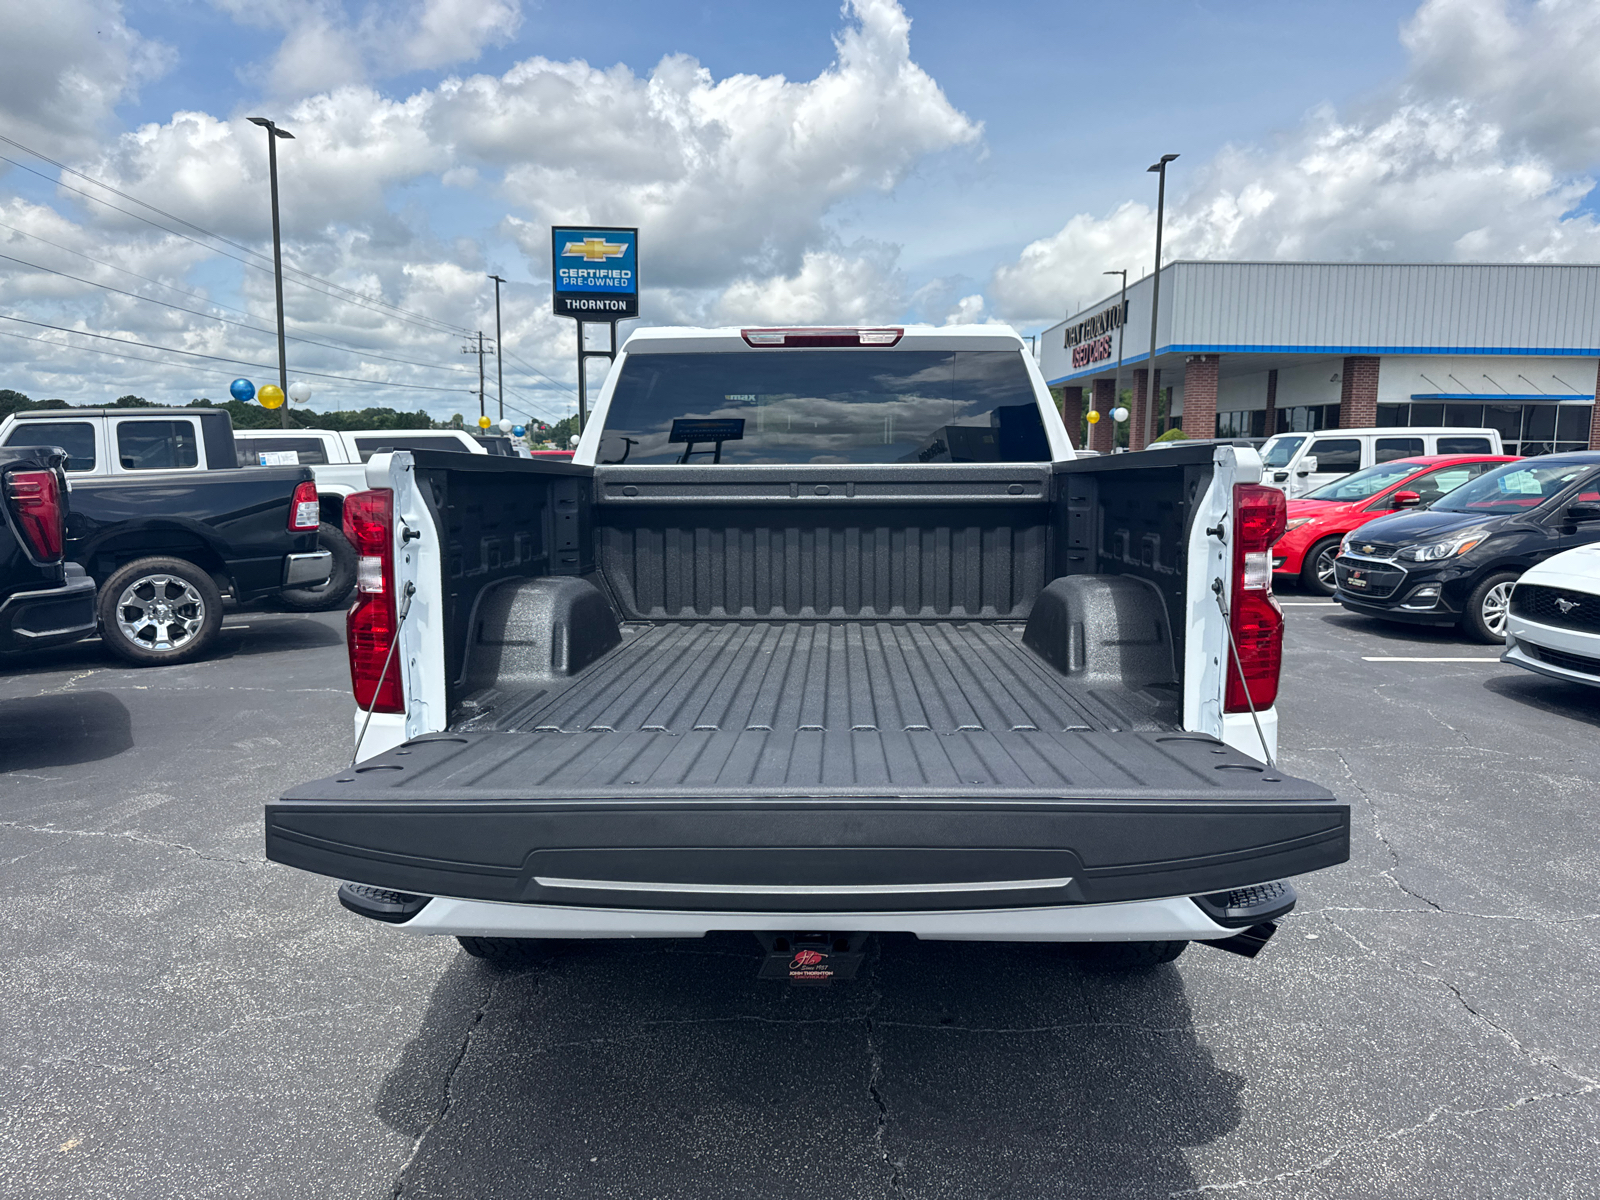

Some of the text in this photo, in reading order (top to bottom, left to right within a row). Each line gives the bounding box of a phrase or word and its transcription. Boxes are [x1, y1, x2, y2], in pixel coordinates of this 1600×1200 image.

[559, 268, 632, 278] CERTIFIED
[563, 277, 628, 287] PRE-OWNED
[565, 299, 627, 310] THORNTON
[1072, 335, 1112, 368] USED CARS
